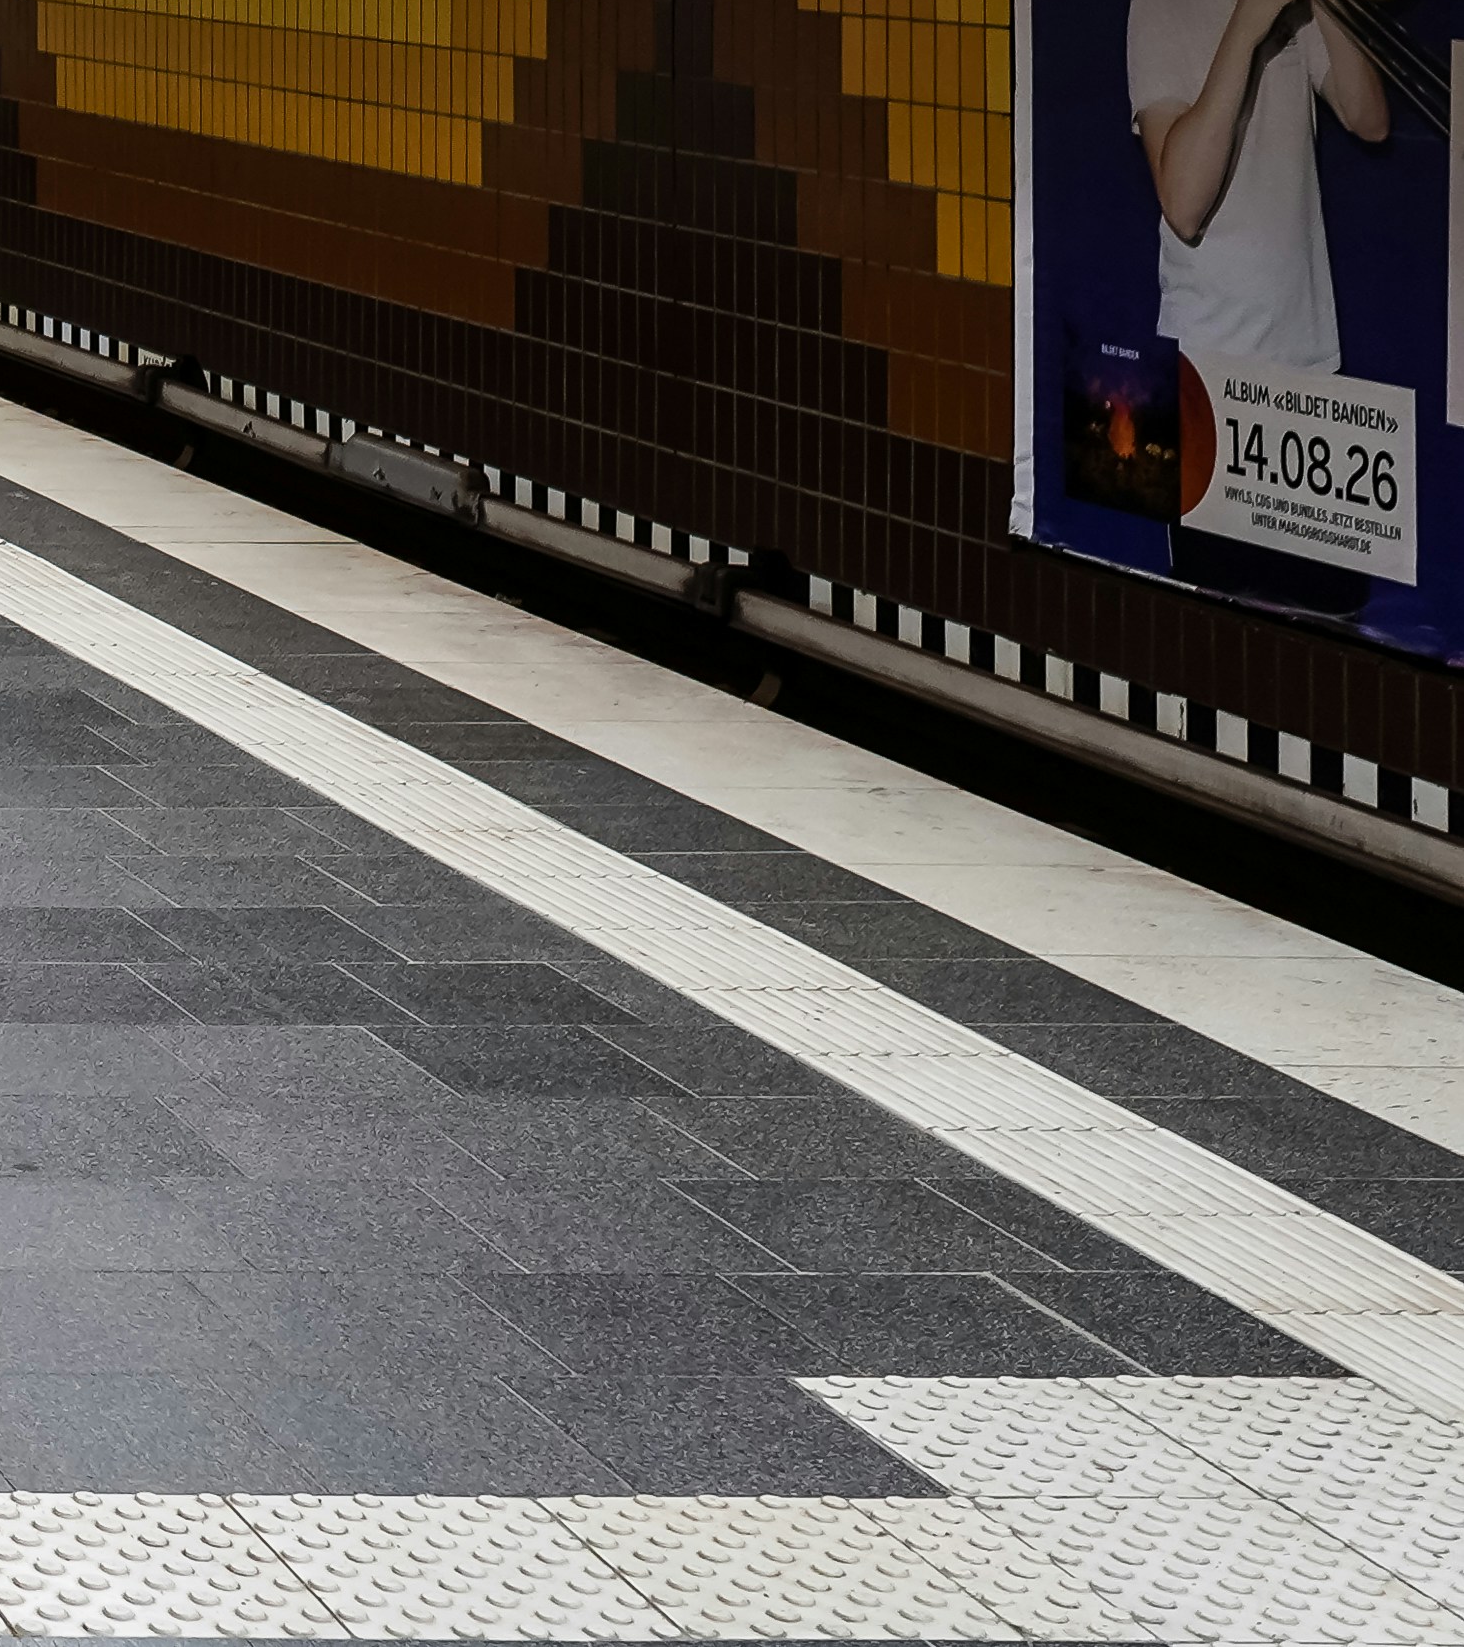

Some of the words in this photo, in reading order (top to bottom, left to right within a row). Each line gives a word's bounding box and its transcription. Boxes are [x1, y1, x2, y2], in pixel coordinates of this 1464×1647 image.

[1223, 377, 1271, 409] ALBUM
[1272, 390, 1330, 420] «BILDET
[1331, 398, 1400, 434] BANDEN»
[1225, 417, 1399, 512] 14.08.26
[1251, 511, 1278, 531] UNTER
[1329, 511, 1354, 529] JETZT
[1354, 516, 1402, 541] BESTELLEN
